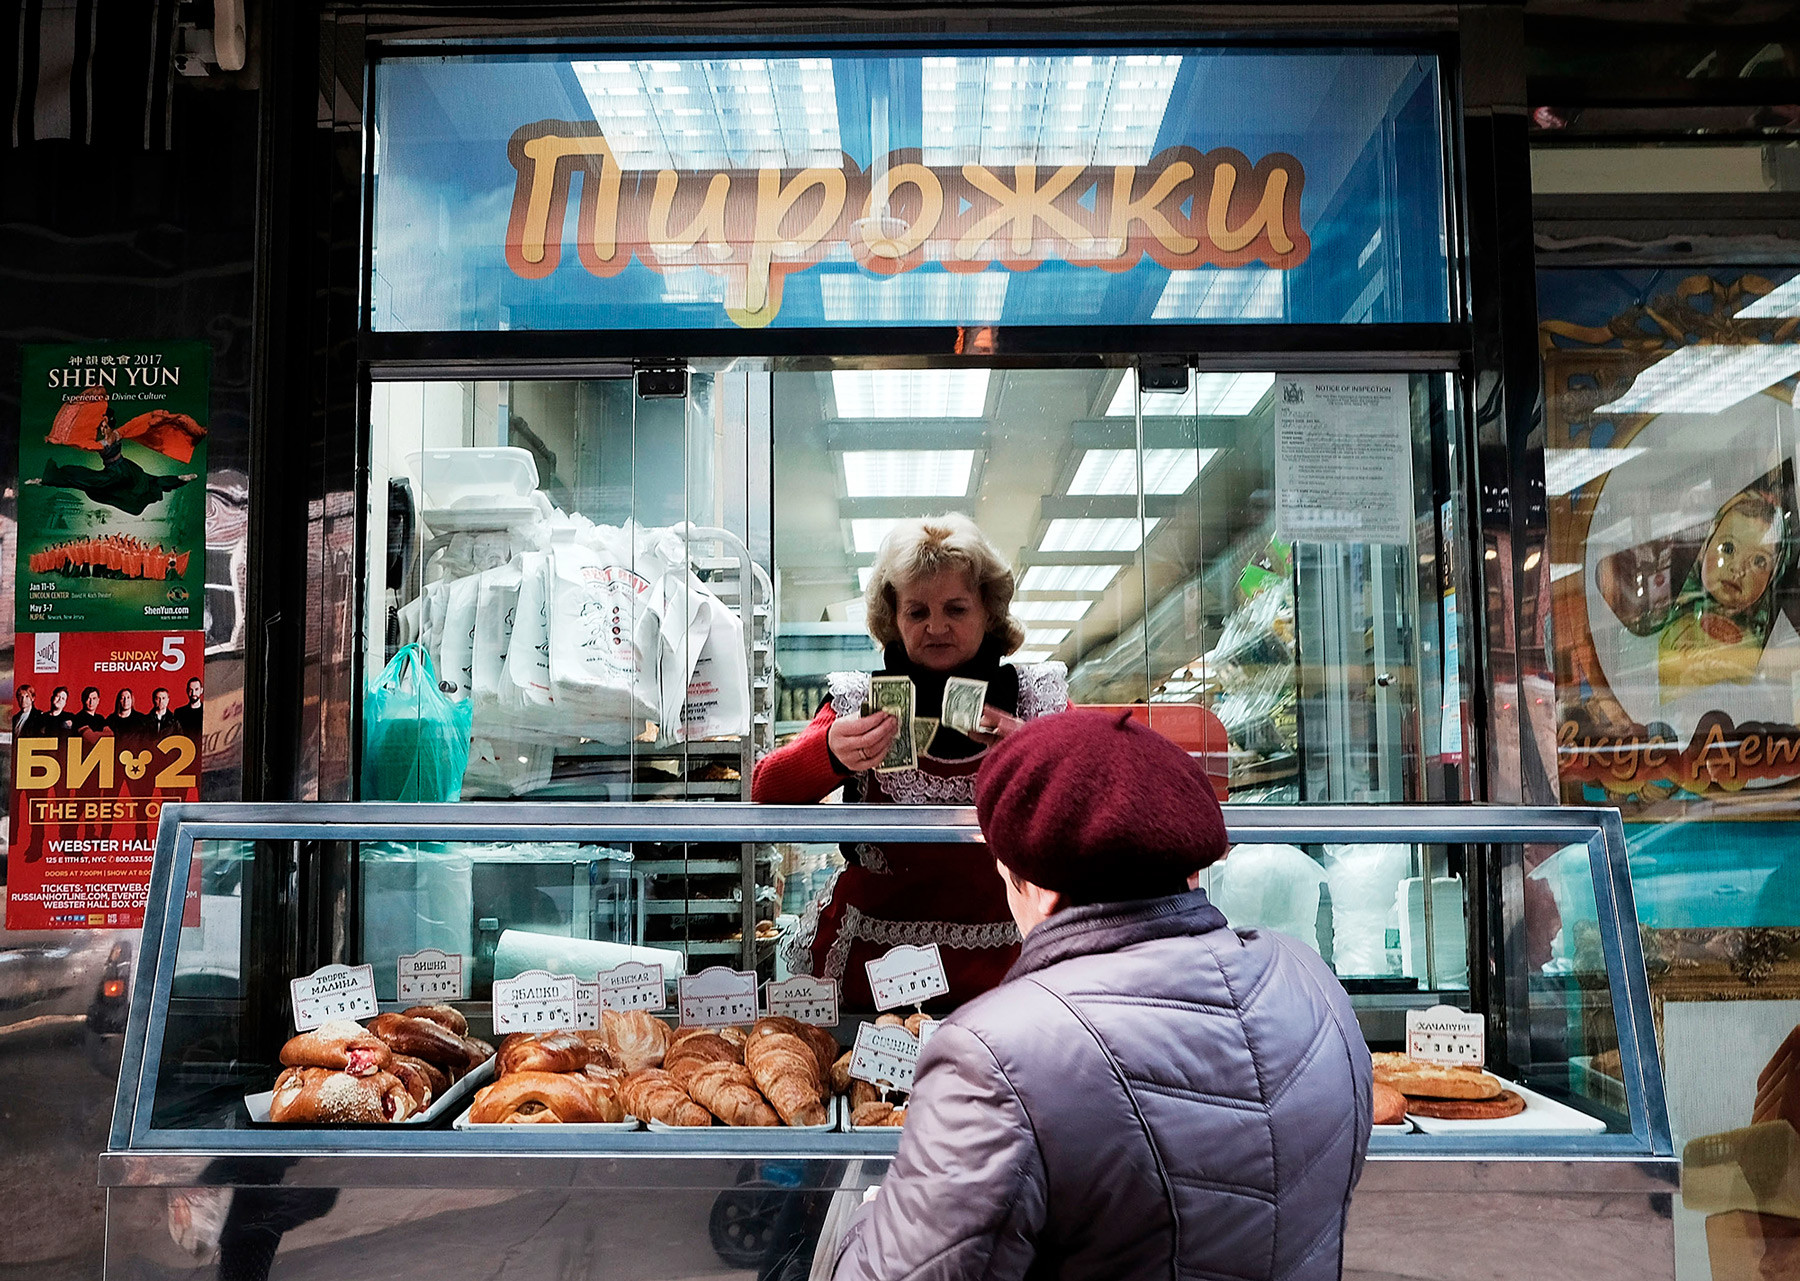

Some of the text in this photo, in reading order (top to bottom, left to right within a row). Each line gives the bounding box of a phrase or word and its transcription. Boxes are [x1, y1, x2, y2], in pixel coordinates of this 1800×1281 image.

[524, 135, 1295, 314] Пирожки
[134, 354, 163, 365] 2017
[48, 367, 181, 388] SHEN YUN
[1315, 385, 1340, 393] NOTICE
[1351, 385, 1392, 393] INSPECTION
[62, 393, 104, 404] Experience
[111, 392, 137, 401] Divine
[137, 391, 167, 401] Culture
[29, 582, 56, 591] Jan 11-15
[50, 591, 70, 599] CENTER
[29, 603, 53, 613] May 3-7
[144, 605, 190, 615] ShenYun.com
[94, 636, 186, 672] FEBRUARY 5
[110, 650, 158, 661] SUNDAY
[36, 802, 160, 819] THE BEST O
[48, 840, 119, 852] WEBSTER
[46, 856, 57, 864] 125
[115, 855, 153, 863] 800.533.50
[40, 883, 150, 893] TICKETS: TICKETWEB.C
[11, 892, 110, 902] RUSSIANHOTLINE.COM,
[43, 901, 85, 909] WEBSTER
[86, 900, 110, 909] HALL
[111, 900, 130, 908] BOX
[413, 960, 447, 971] ВИШНЯ
[311, 977, 359, 996] МАЛИНА
[511, 986, 559, 1001] ЯБЛОКО
[784, 987, 812, 998] МАК
